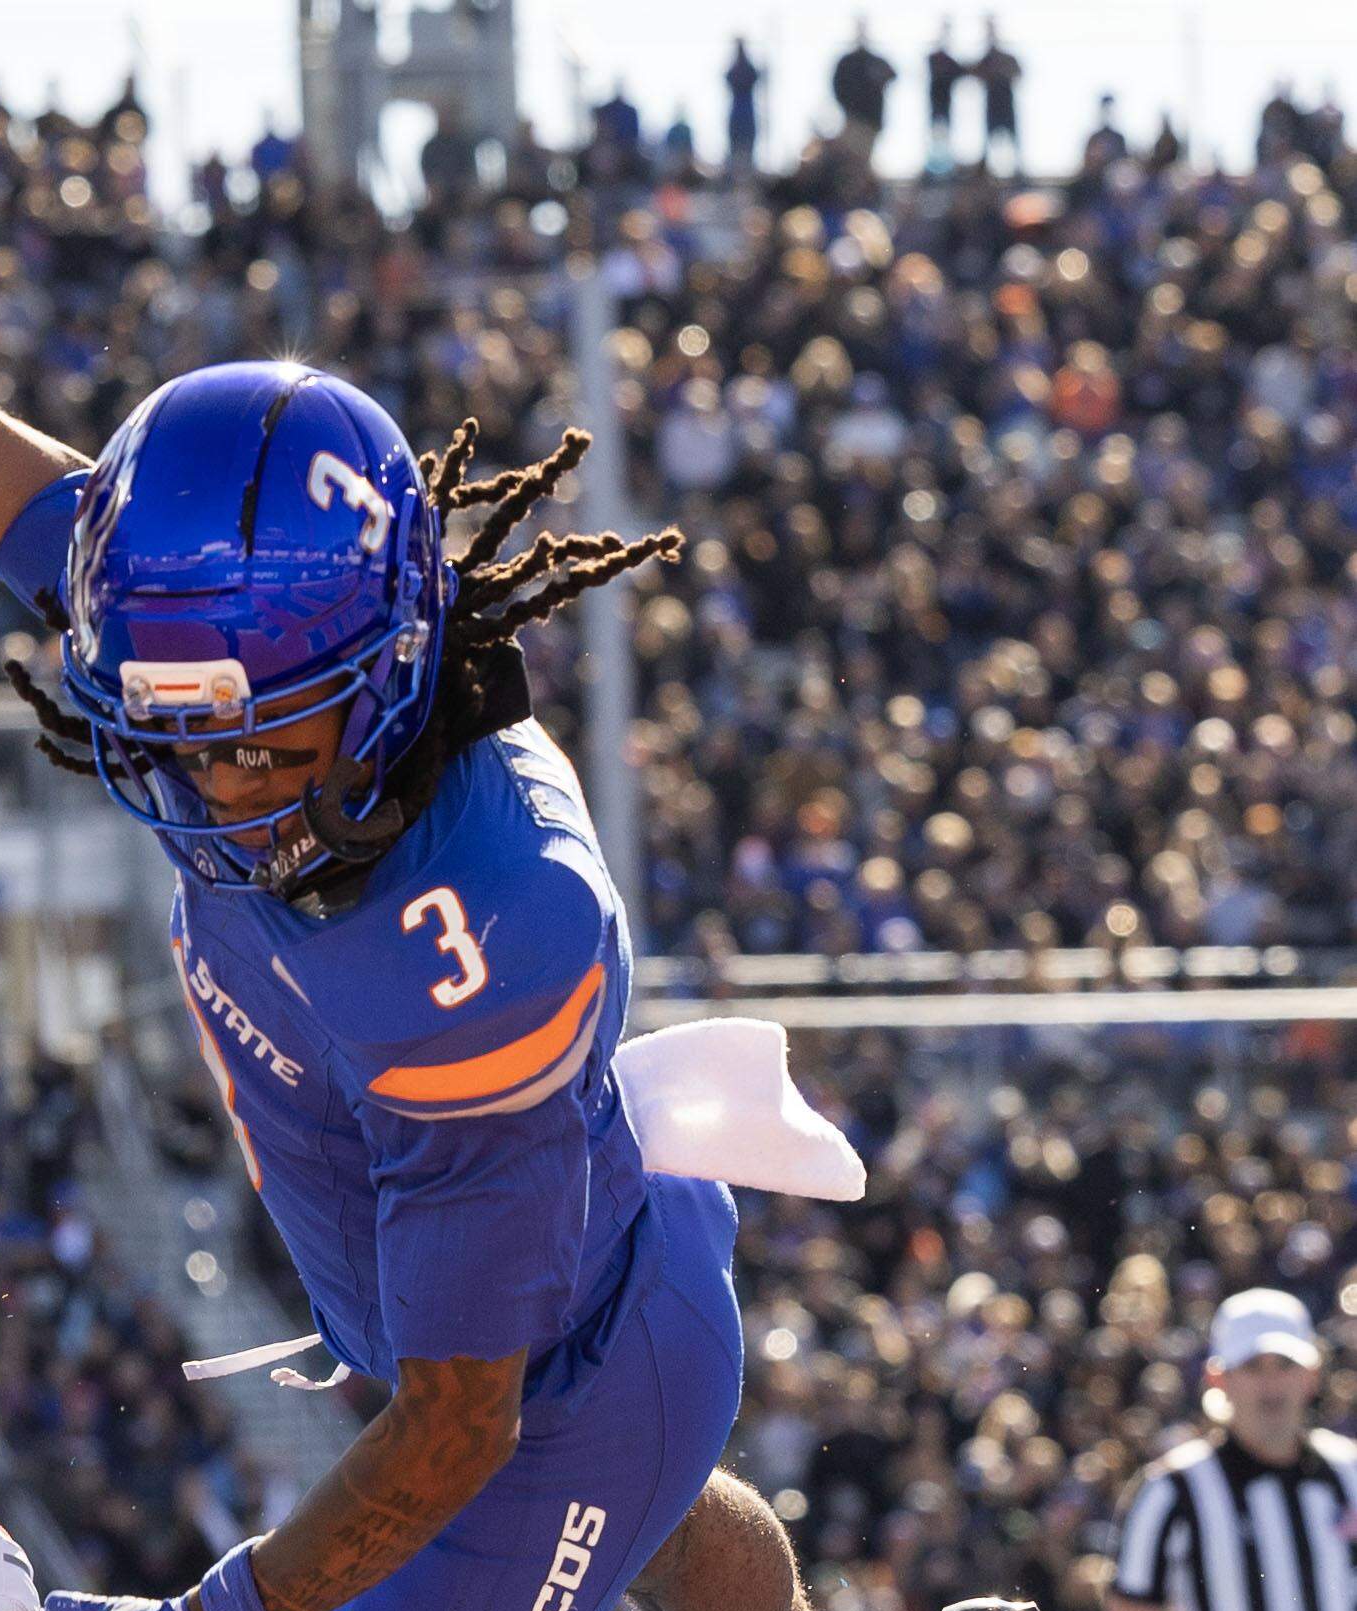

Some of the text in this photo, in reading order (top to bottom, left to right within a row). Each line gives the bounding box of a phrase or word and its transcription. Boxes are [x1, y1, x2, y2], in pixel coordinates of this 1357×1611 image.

[306, 450, 391, 555] 3
[235, 747, 273, 770] RUM
[400, 886, 489, 1009] 3
[189, 956, 305, 1088] STATE
